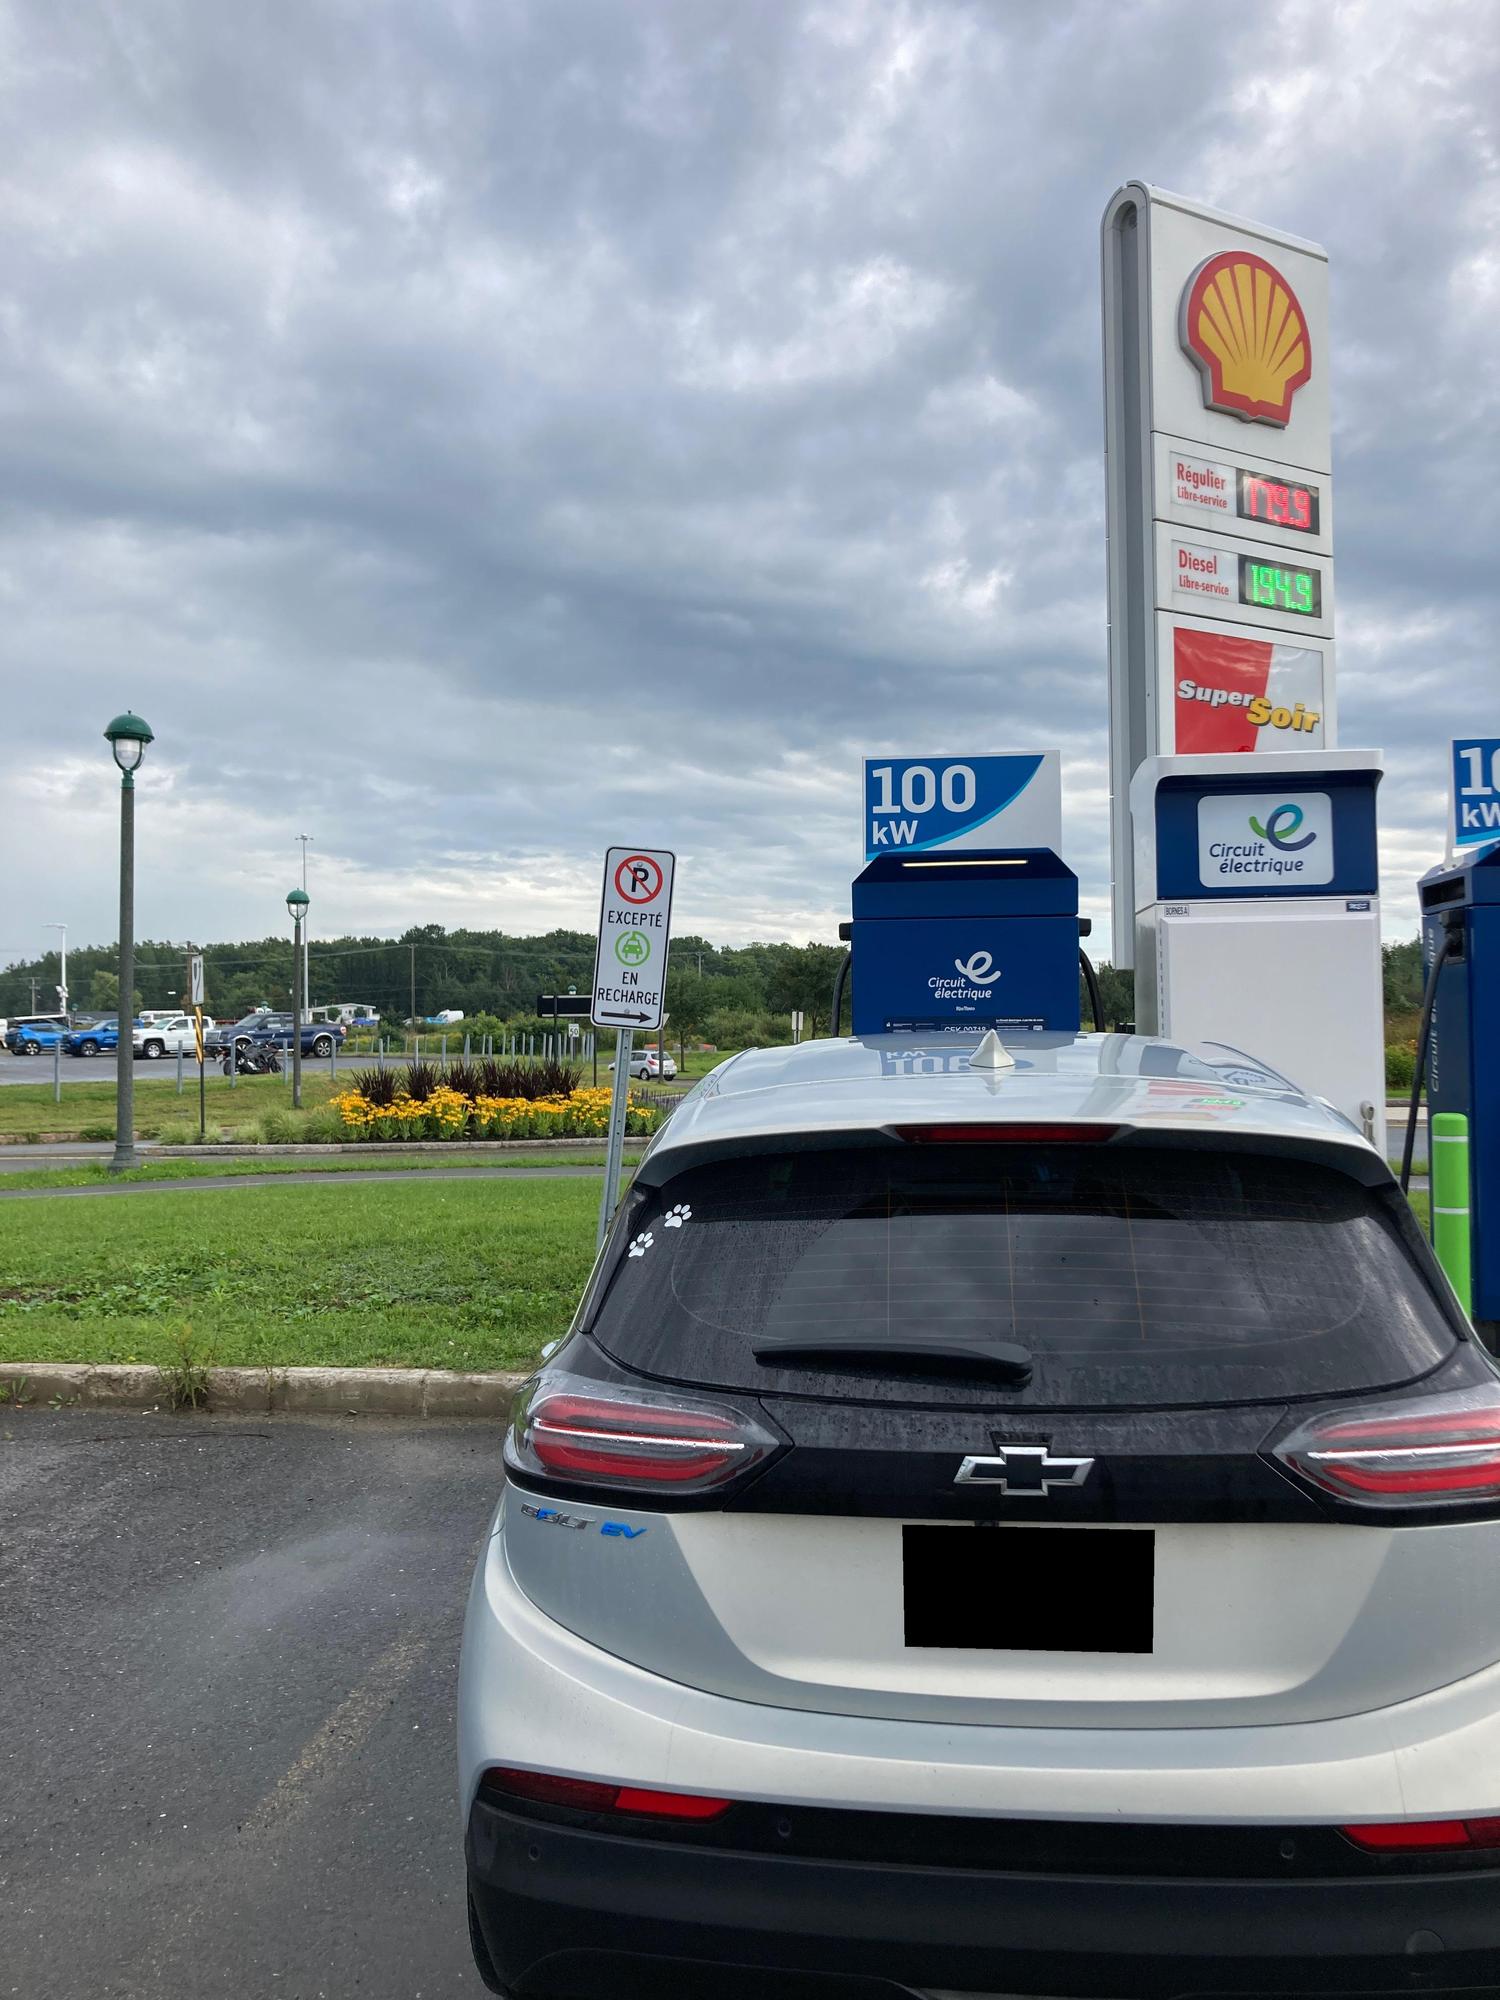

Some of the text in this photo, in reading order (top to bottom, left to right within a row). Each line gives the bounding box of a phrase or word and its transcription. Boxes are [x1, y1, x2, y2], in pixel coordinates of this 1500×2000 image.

[1177, 463, 1226, 490] Régulier
[1177, 486, 1228, 509] Libre-service
[1179, 550, 1217, 574] Diesel
[1179, 575, 1229, 596] Libre-service
[1251, 565, 1313, 612] 194.9
[1177, 679, 1321, 733] Super Soir
[1460, 747, 1500, 795] 1
[872, 764, 976, 814] 100
[872, 820, 918, 845] kW
[1209, 842, 1265, 858] Circuit
[1219, 857, 1303, 875] électrique
[608, 910, 662, 928] EXCEPTÉ
[622, 971, 638, 986] EN
[928, 977, 966, 987] Circuit
[597, 988, 658, 1006] RECHARGE
[934, 988, 992, 1000] électrique
[600, 1520, 647, 1539] EV
